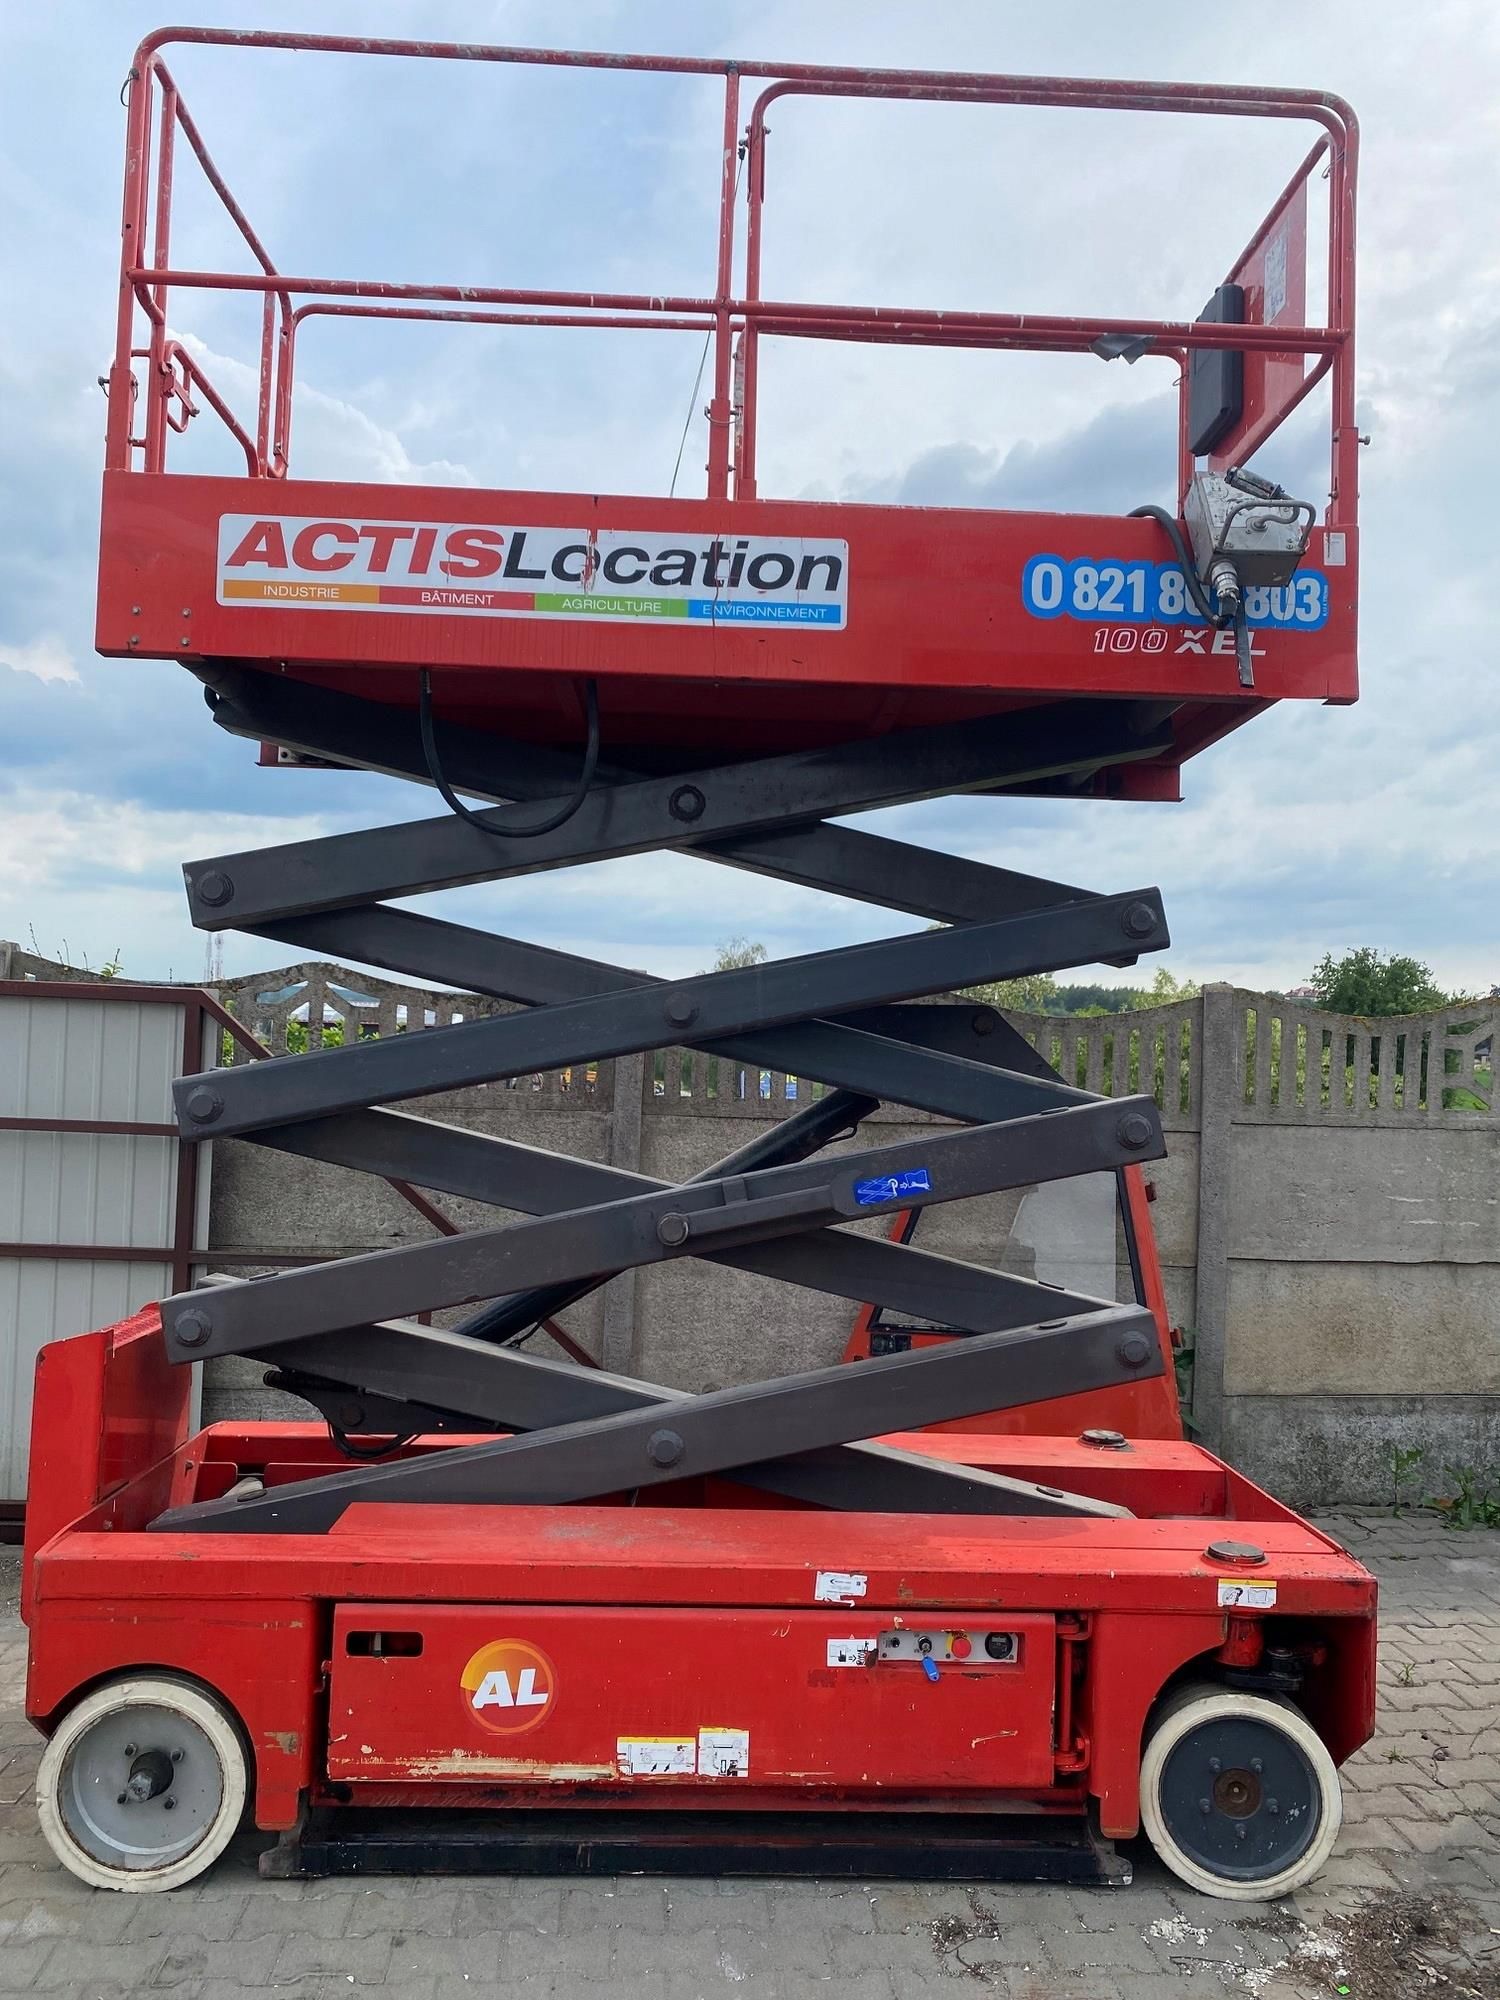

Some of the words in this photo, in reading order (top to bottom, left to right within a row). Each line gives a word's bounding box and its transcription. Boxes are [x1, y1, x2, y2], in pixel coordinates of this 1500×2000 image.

[263, 584, 340, 599] INDUSTRIE
[421, 589, 495, 606] BÂTIMENT
[562, 598, 662, 614] AGRICULTURE
[702, 604, 827, 620] ENVIRONNEMENT
[1031, 563, 1063, 610] 0
[1073, 566, 1145, 613] 821
[1245, 577, 1321, 622] 803
[1094, 628, 1168, 653] 100
[1174, 629, 1267, 656] XEL
[471, 1668, 549, 1709] AL
